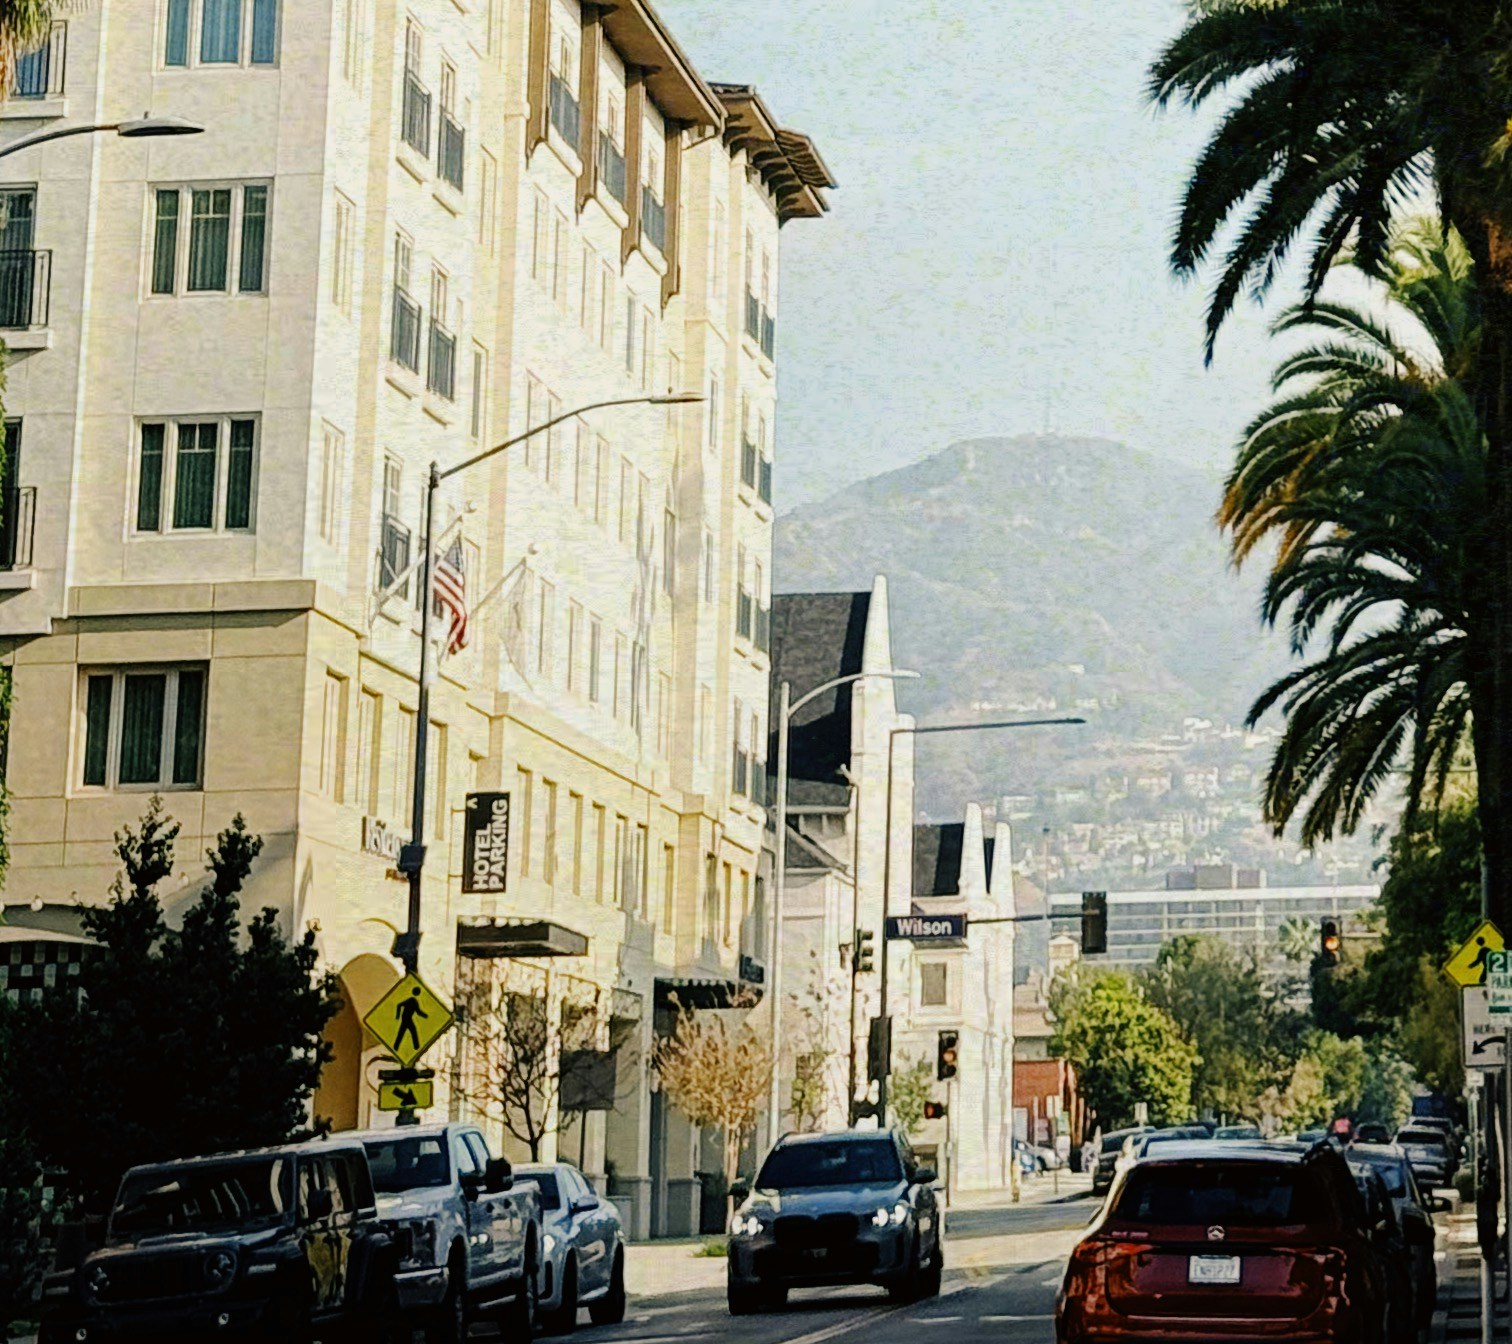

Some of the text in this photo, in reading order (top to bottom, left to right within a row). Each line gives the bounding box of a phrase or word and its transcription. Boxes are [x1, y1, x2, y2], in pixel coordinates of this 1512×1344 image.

[472, 822, 492, 890] HOTEL
[488, 798, 508, 890] PARKING
[896, 917, 953, 936] Wilson
[1491, 952, 1505, 973] 2
